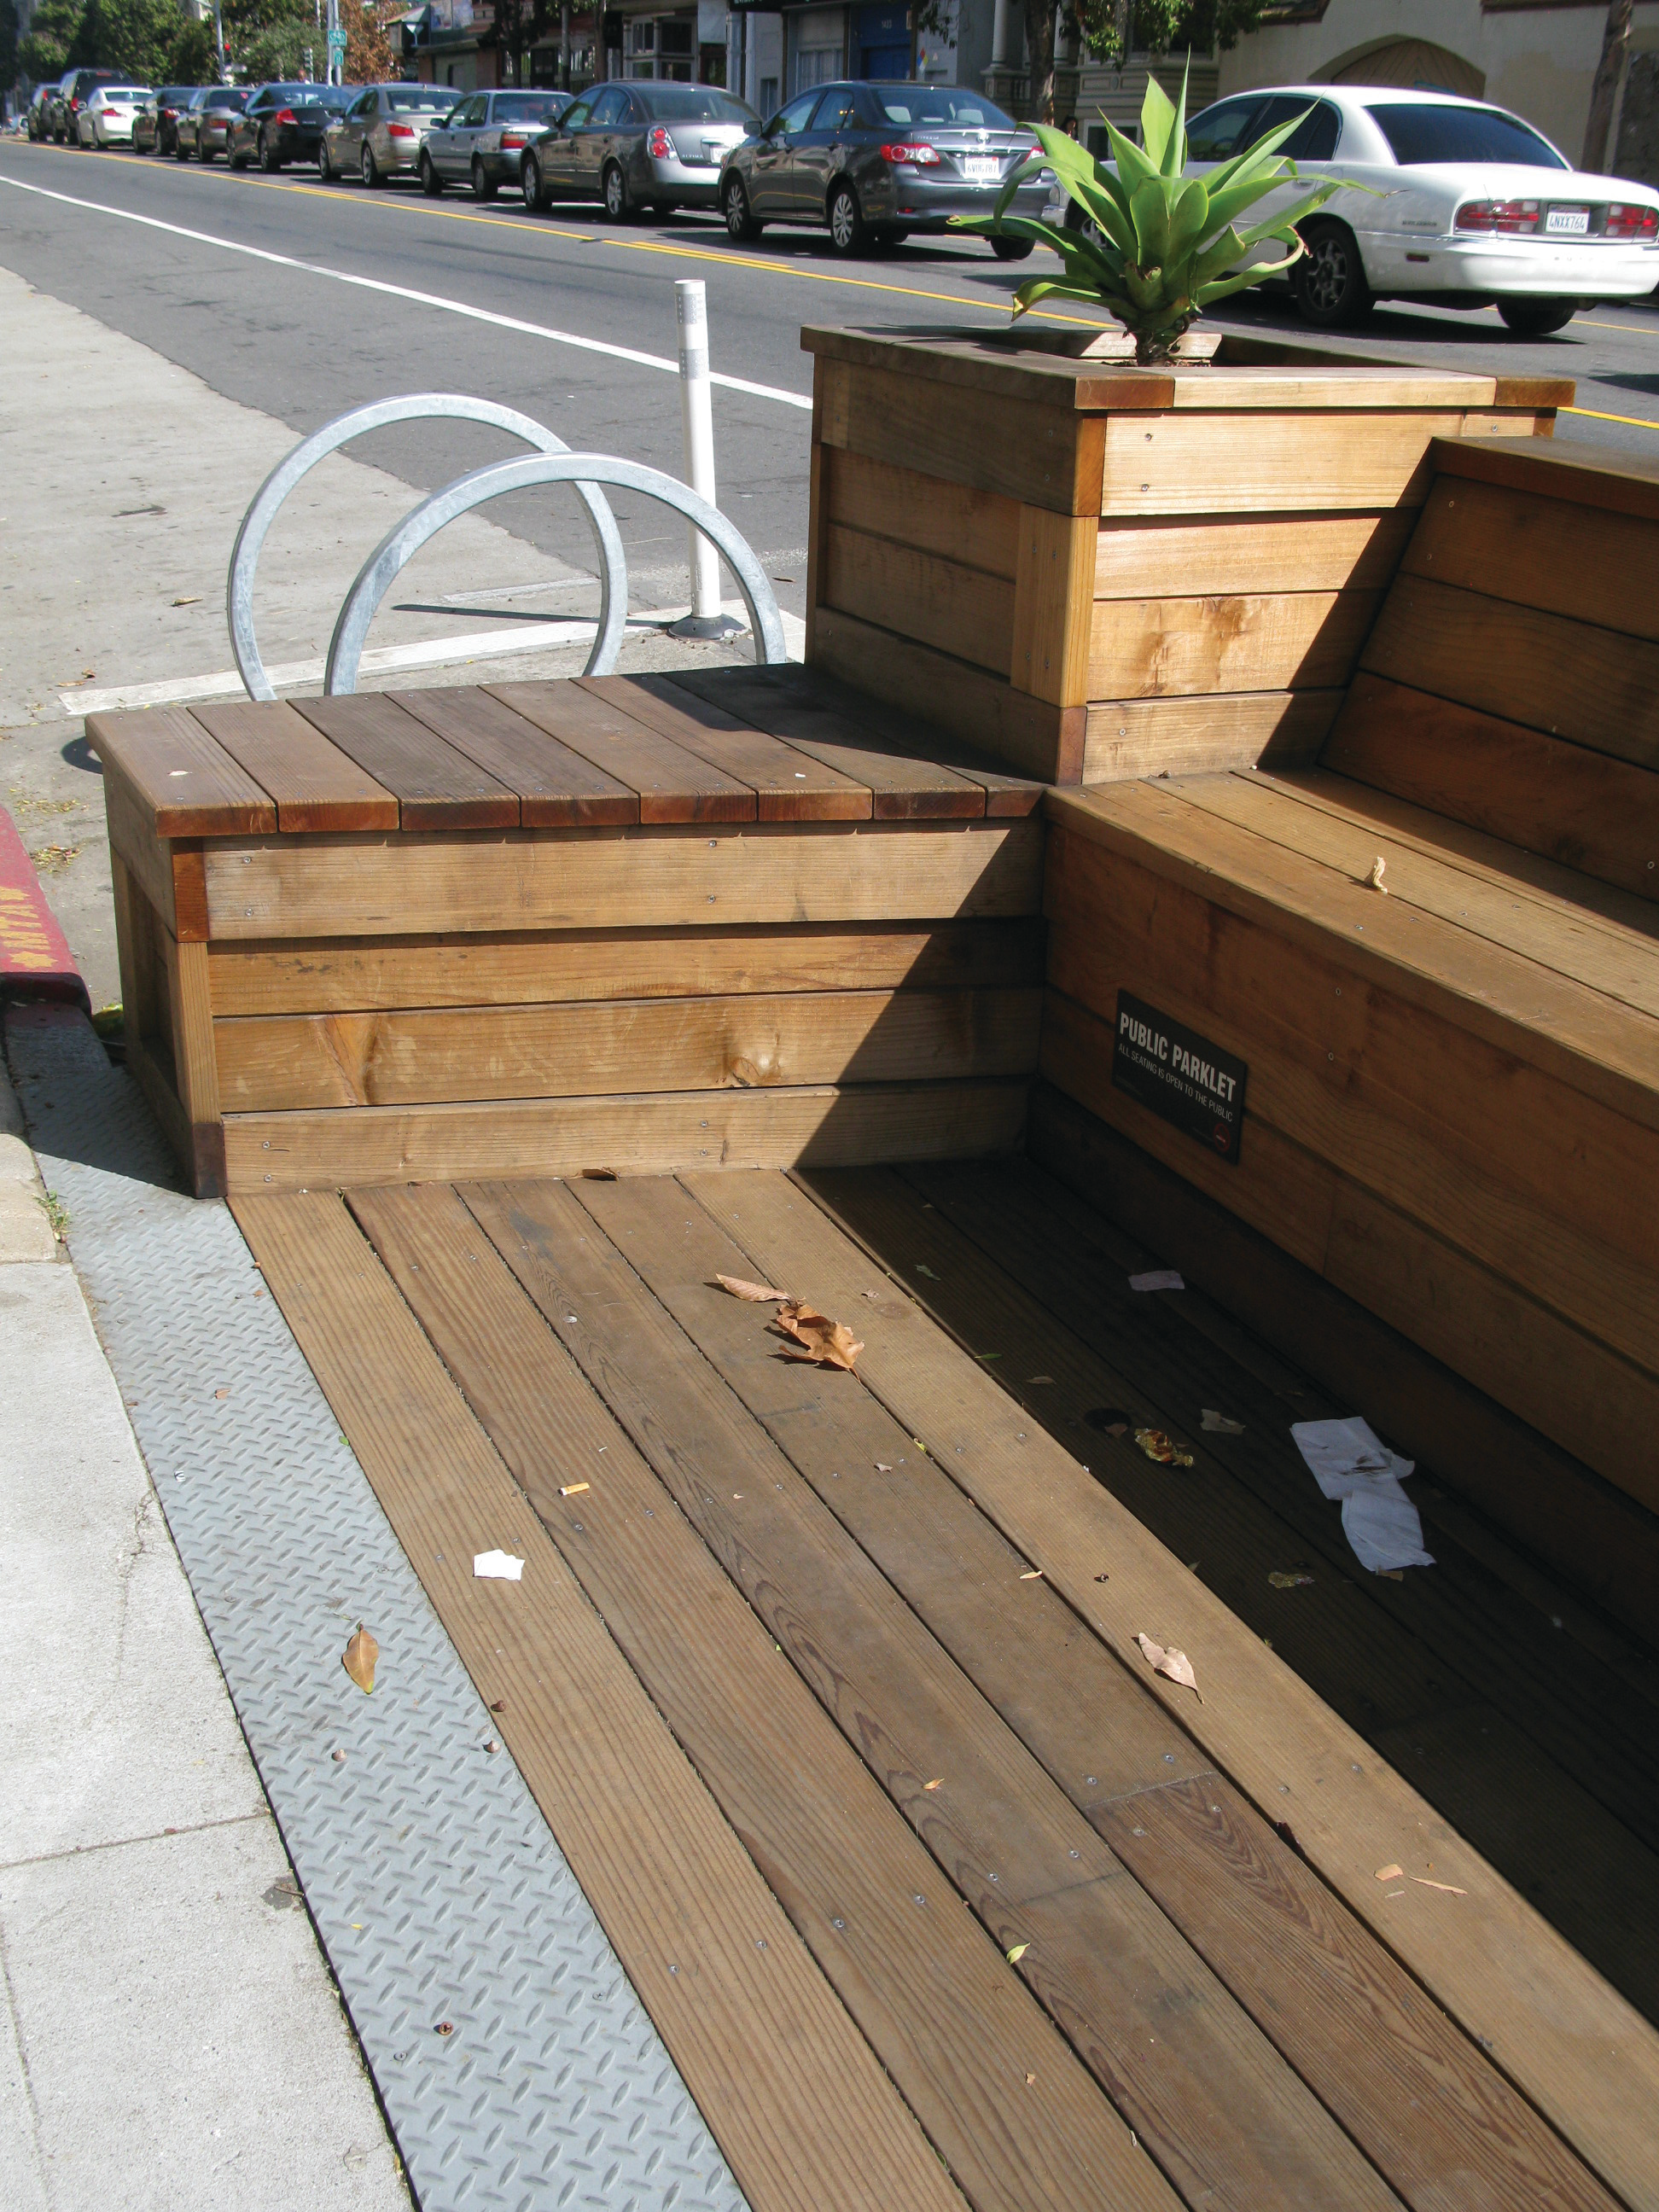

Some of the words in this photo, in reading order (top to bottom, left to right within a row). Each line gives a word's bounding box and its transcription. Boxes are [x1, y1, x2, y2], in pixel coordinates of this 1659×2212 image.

[1548, 214, 1585, 230] 4NXX764
[1118, 1043, 1131, 1058] ALL
[1131, 1051, 1157, 1074] SEATING
[1158, 1067, 1165, 1079] IS
[1166, 1072, 1183, 1091] OPEN
[1185, 1083, 1193, 1097] TO
[1195, 1091, 1208, 1107] THE
[1208, 1099, 1233, 1122] PUBLIC
[1120, 1011, 1168, 1061] PUBLIC
[1172, 1044, 1237, 1103] PARKLET
